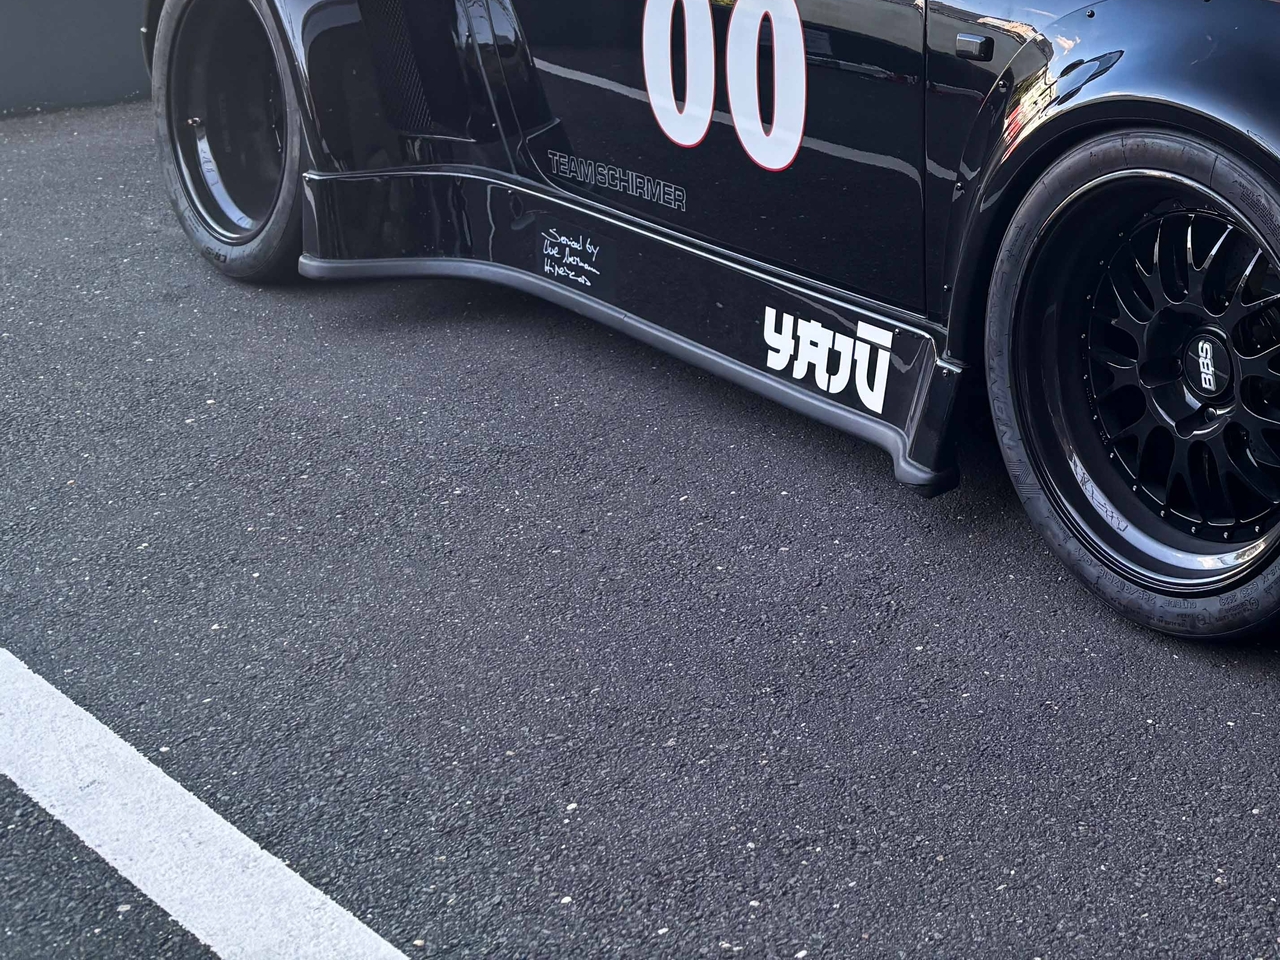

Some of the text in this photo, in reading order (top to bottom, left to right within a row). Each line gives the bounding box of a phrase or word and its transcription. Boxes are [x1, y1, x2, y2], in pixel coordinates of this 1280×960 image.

[548, 149, 686, 212] TEAM SCHIRMER
[586, 238, 600, 261] by
[1198, 340, 1216, 391] BBS
